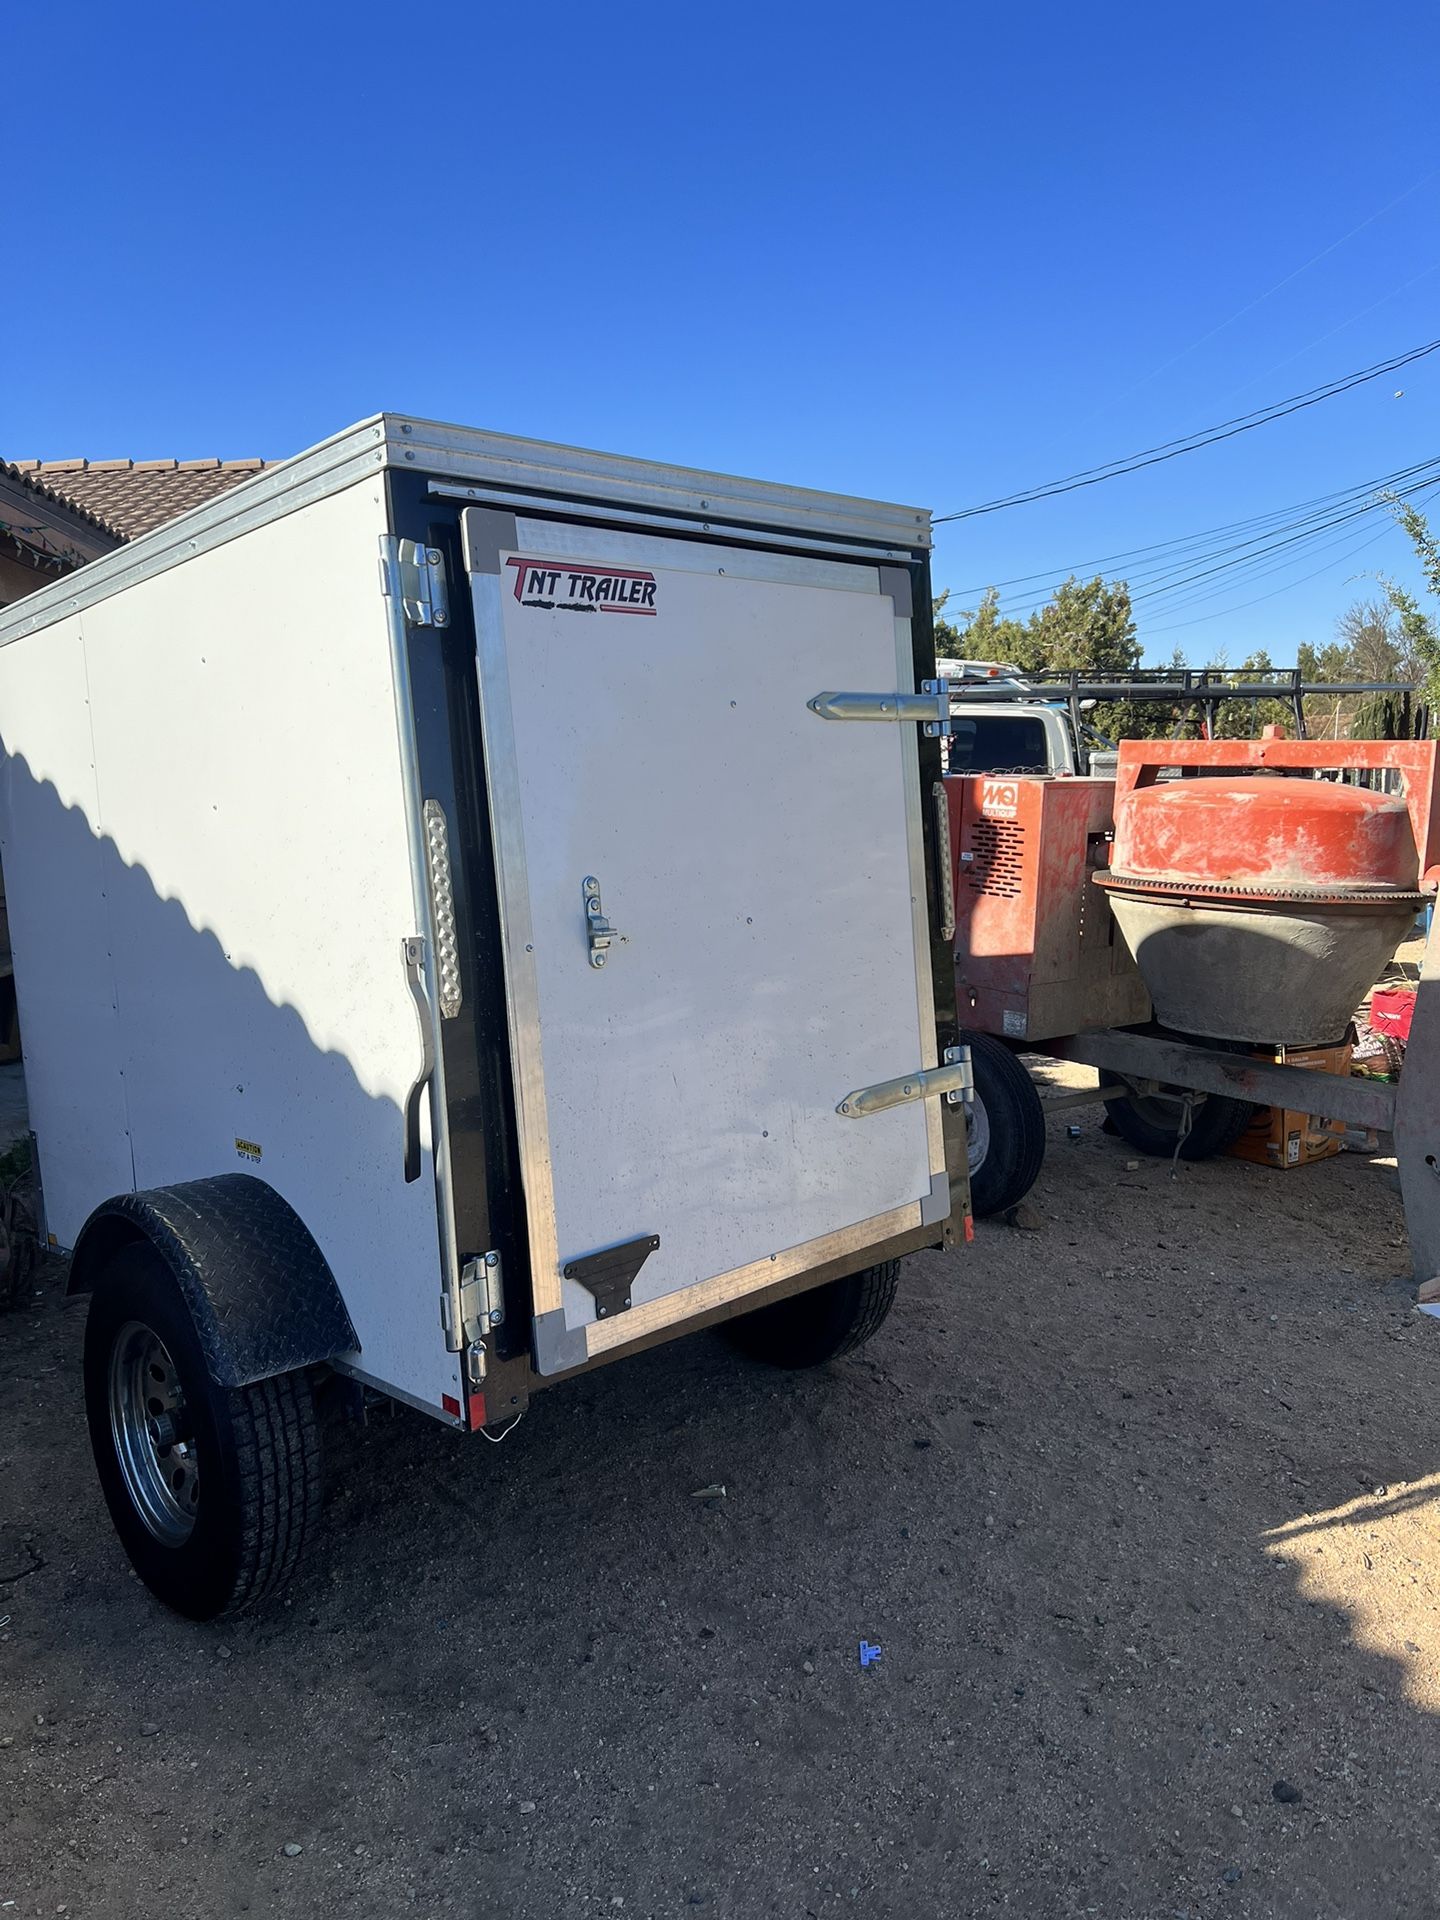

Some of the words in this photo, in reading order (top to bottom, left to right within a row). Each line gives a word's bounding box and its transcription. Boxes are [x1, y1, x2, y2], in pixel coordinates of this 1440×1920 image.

[506, 557, 561, 602] TNT
[567, 574, 657, 607] TRAILER
[983, 785, 1017, 806] MQ
